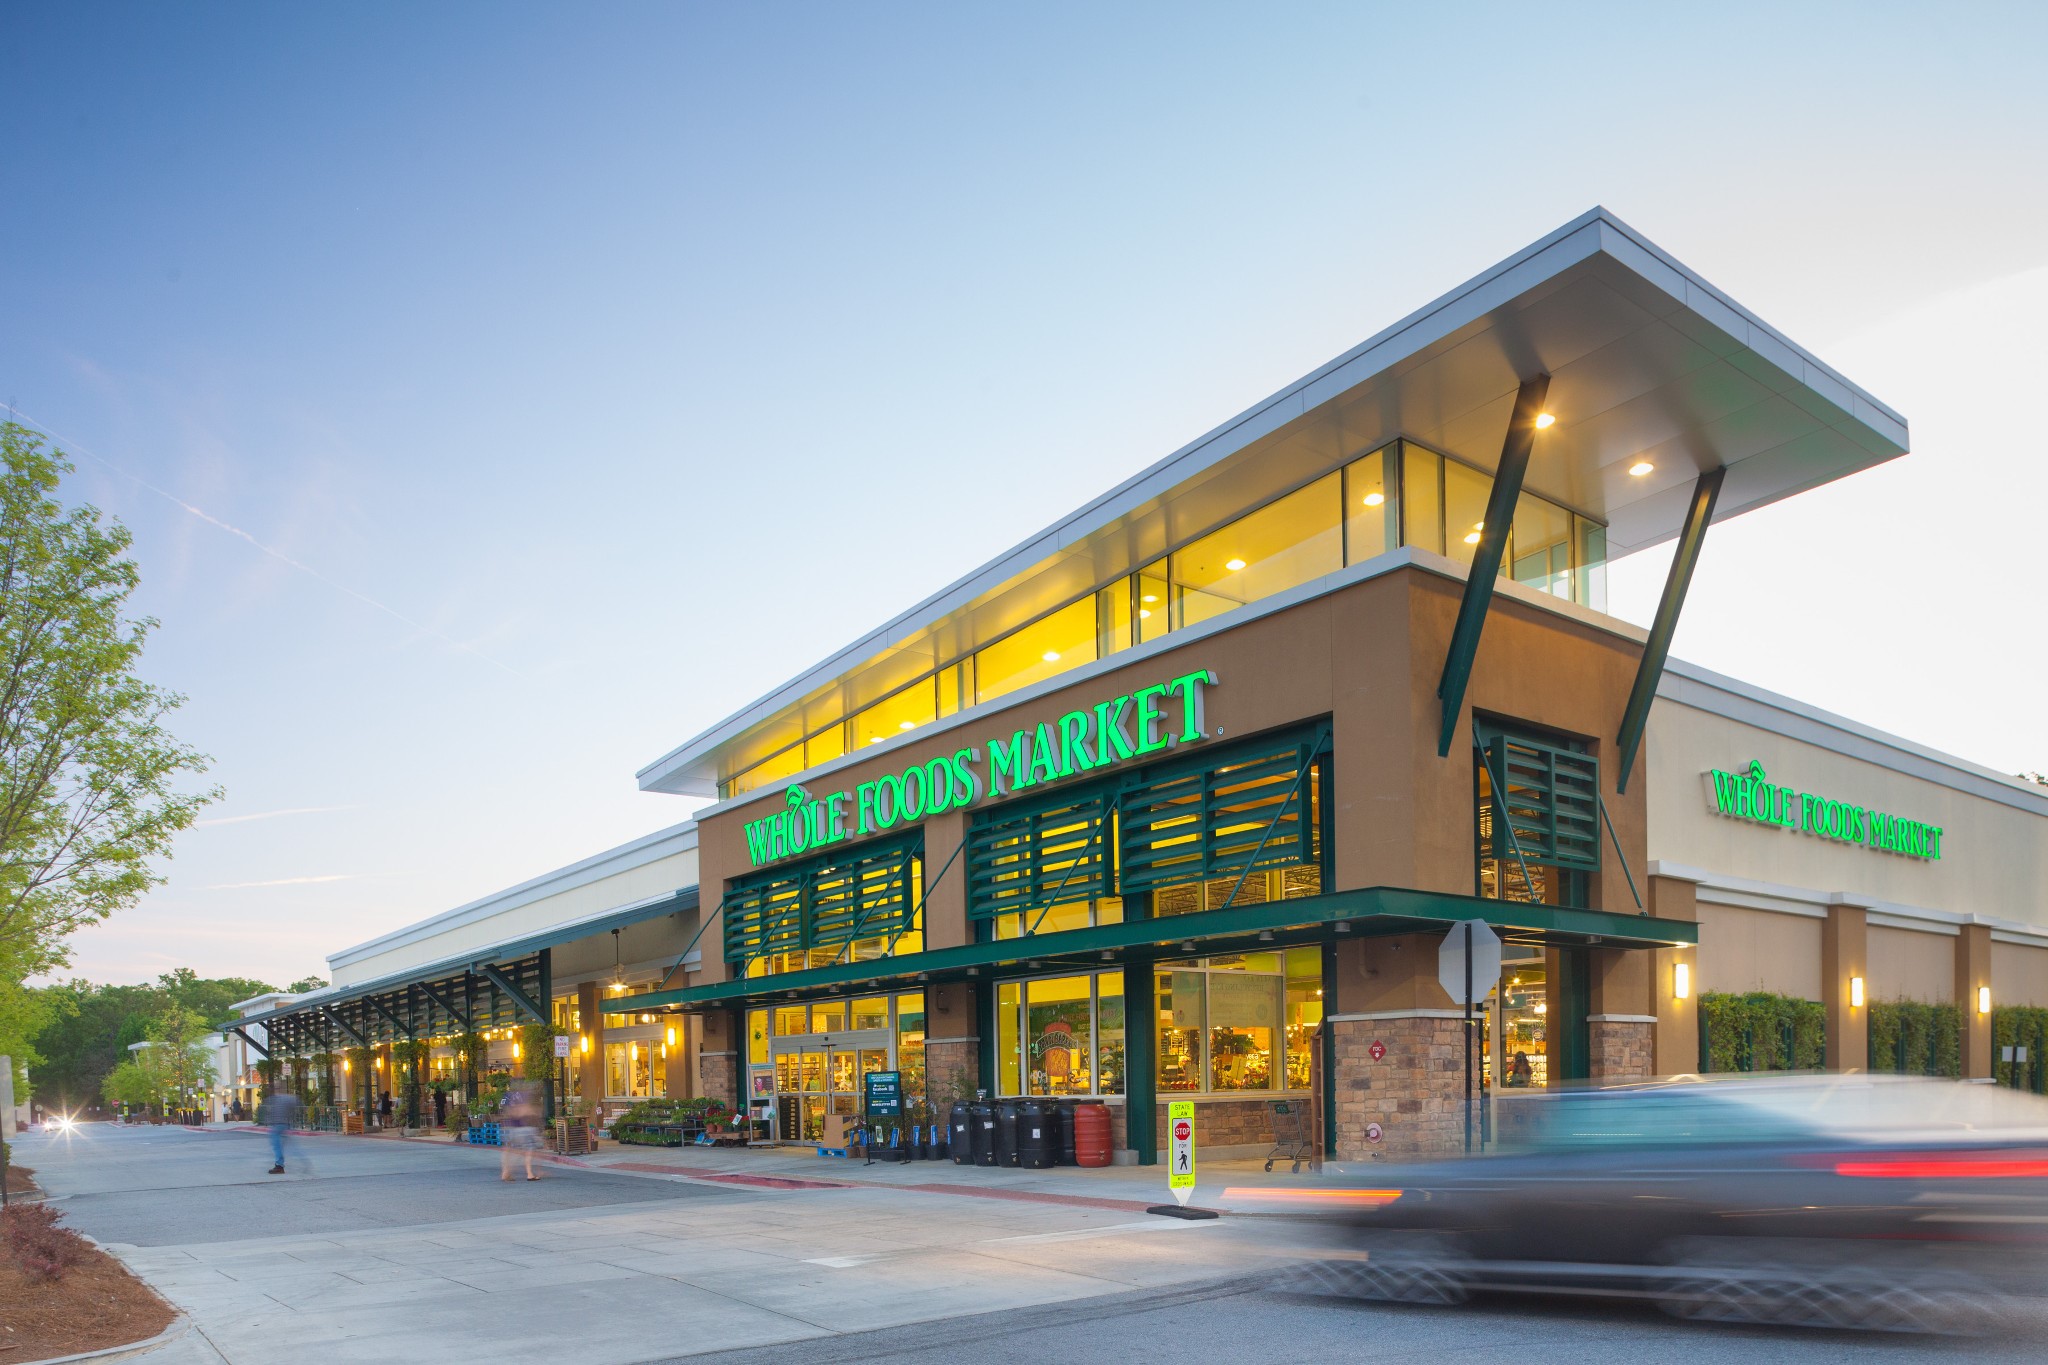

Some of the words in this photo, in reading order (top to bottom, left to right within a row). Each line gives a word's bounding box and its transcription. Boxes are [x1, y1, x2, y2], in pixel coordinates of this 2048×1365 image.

[744, 785, 851, 867] WHOLE
[856, 748, 979, 835] FOODS
[987, 670, 1212, 797] MARKET
[1711, 759, 1794, 828] WHOLE
[1801, 793, 1865, 844] FOODS
[1869, 810, 1943, 861] MARKET
